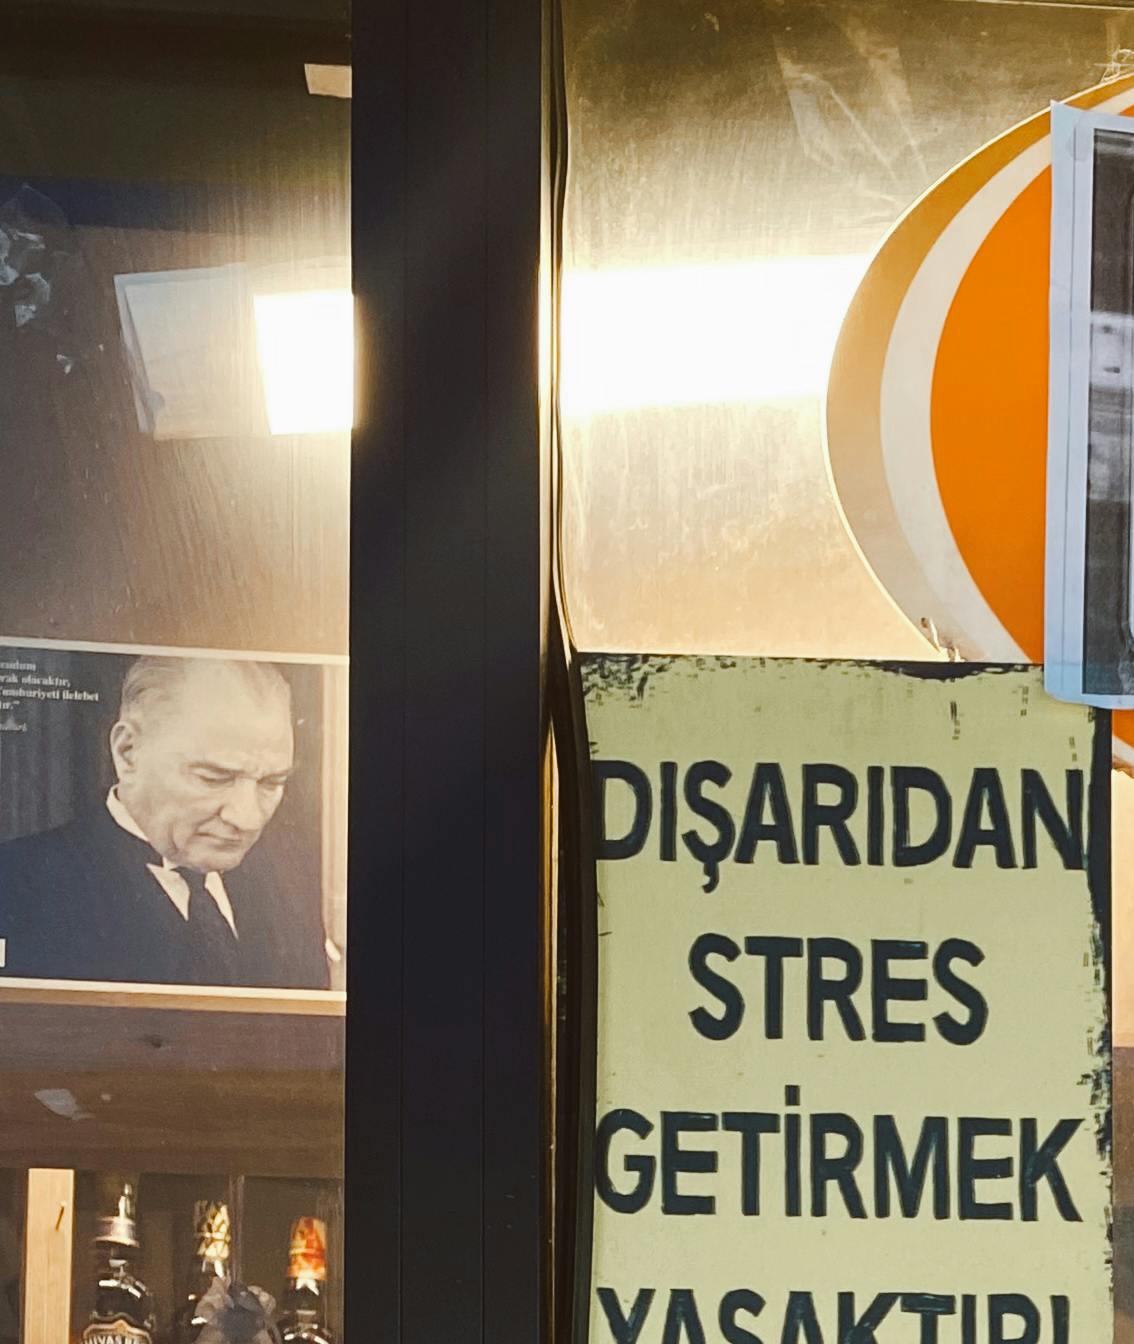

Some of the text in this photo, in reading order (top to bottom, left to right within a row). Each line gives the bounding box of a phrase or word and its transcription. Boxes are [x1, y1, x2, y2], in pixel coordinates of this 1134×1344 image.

[595, 760, 1084, 893] DIŞARIDAN
[688, 932, 990, 1046] STRES
[593, 1084, 1086, 1223] GETİRMEK
